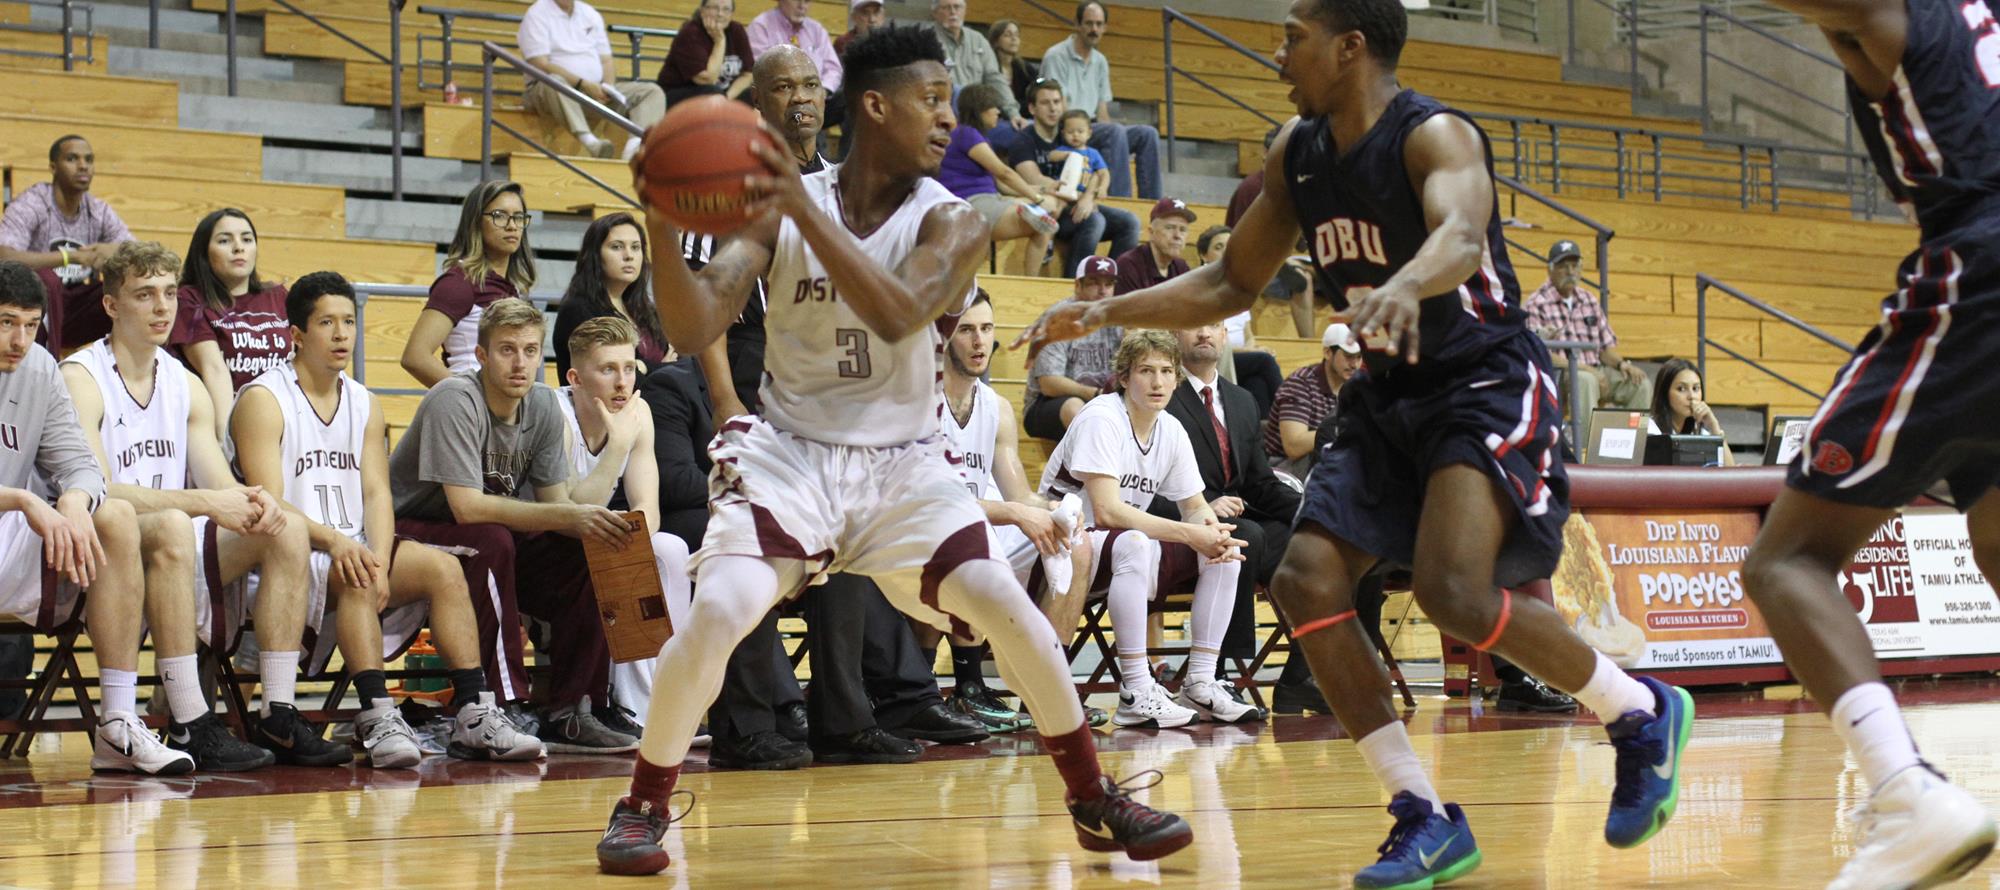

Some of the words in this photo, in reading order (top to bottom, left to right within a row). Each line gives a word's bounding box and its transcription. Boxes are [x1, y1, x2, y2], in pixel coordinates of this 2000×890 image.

[1314, 216, 1389, 268] DBU
[231, 332, 270, 350] What
[273, 333, 286, 349] is
[225, 352, 287, 376] ntegrity
[836, 328, 872, 379] 3
[314, 484, 353, 529] 11
[1868, 517, 1906, 543] ING
[1608, 544, 1699, 565] LOUISIANA
[1913, 539, 1956, 551] OFFICIAL
[1954, 556, 1966, 567] OF
[1871, 565, 1915, 597] LIFE
[1921, 574, 1951, 585] TAMIU
[1655, 615, 1699, 626] LOUISIANA
[1701, 614, 1738, 624] KITCHEN
[1652, 648, 1680, 663] Proud
[1682, 647, 1725, 664] Sponsors
[1728, 646, 1736, 660] of
[1738, 643, 1775, 659] TAMIU!
